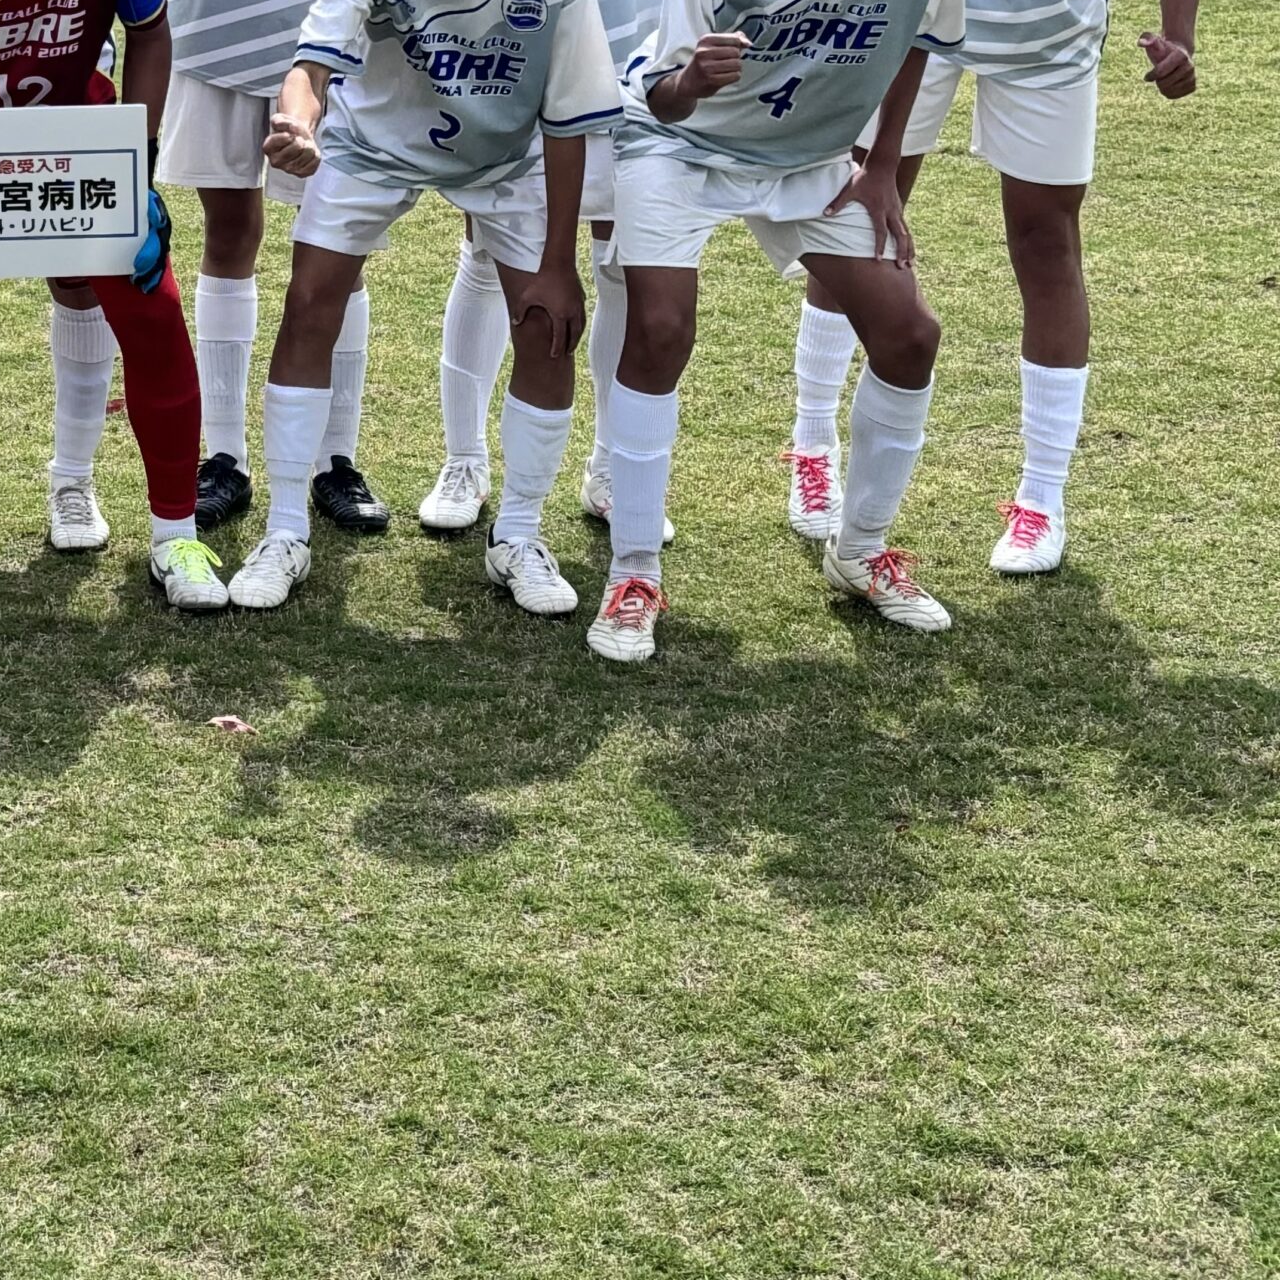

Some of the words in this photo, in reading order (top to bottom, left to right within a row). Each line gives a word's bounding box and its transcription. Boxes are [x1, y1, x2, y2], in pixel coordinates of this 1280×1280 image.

[506, 4, 543, 19] LIBRE
[847, 3, 888, 16] CLUB
[749, 18, 889, 52] LIBRE
[38, 43, 79, 59] 2016
[483, 35, 522, 52] CLUB
[823, 54, 869, 65] 2016
[469, 84, 513, 97] 2016
[758, 76, 803, 120] 4
[428, 110, 462, 153] 2
